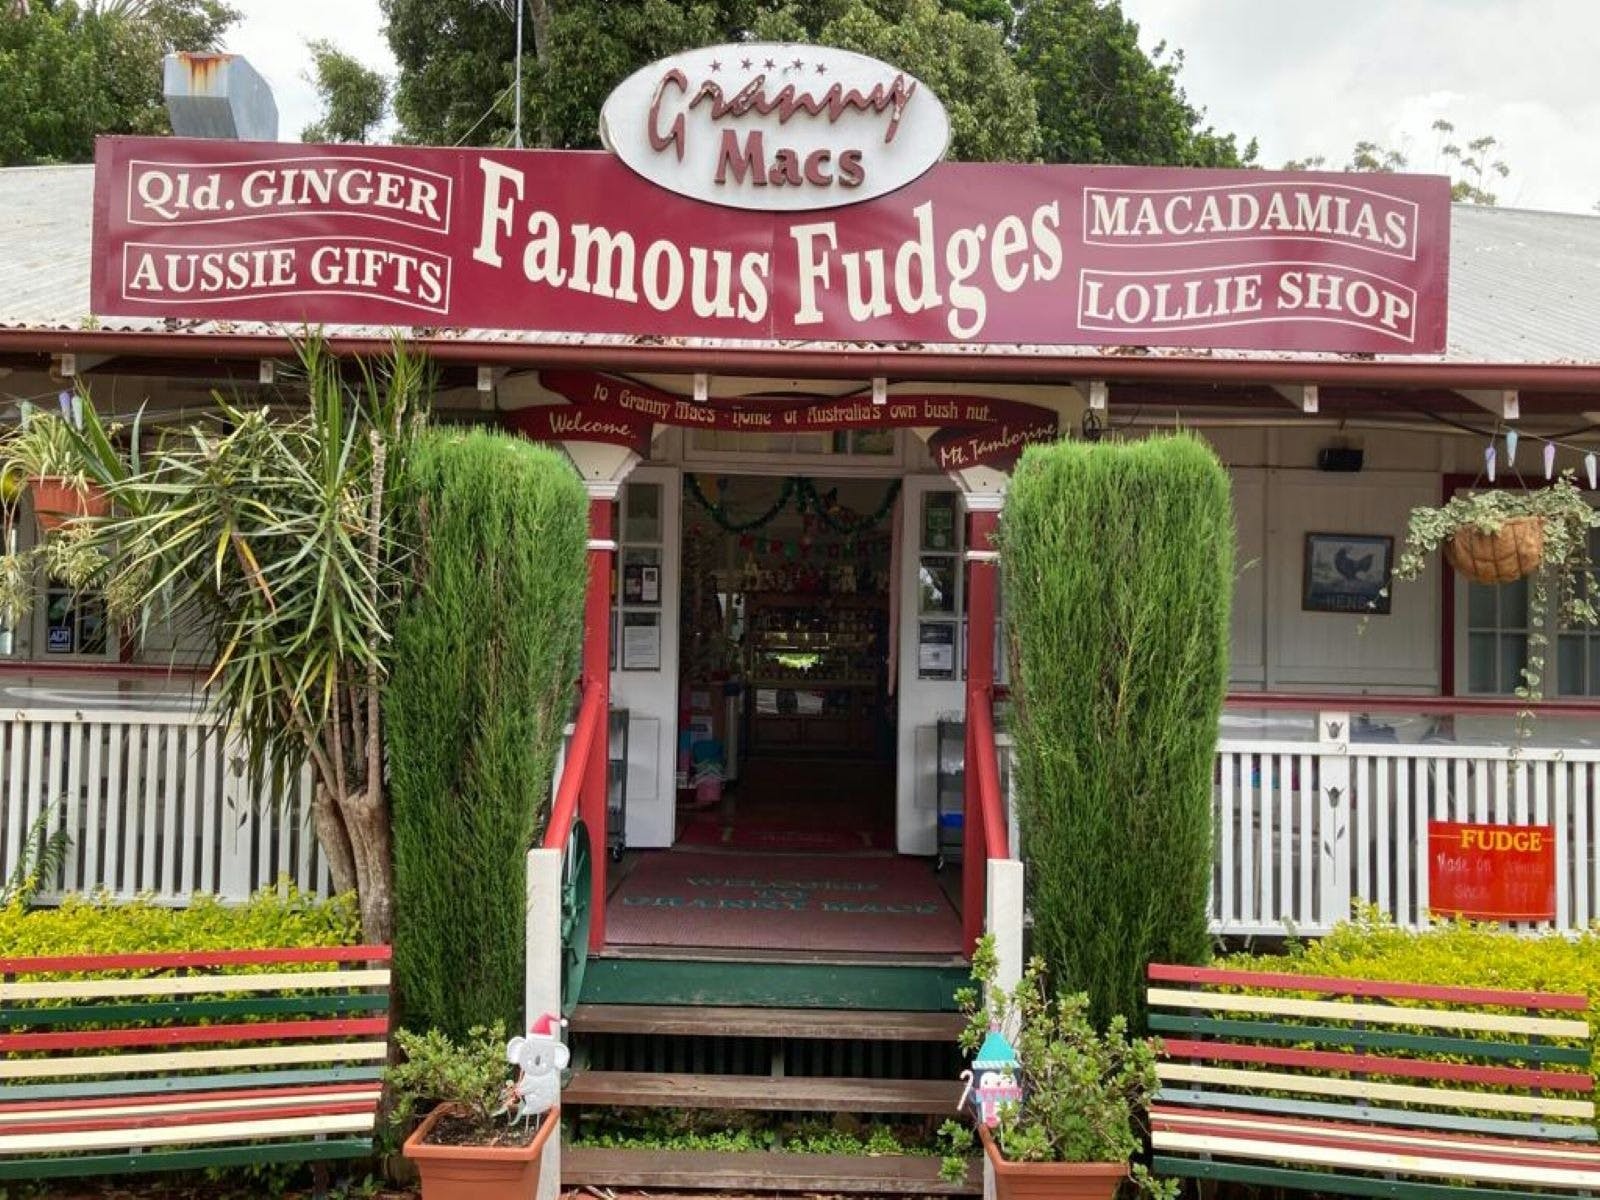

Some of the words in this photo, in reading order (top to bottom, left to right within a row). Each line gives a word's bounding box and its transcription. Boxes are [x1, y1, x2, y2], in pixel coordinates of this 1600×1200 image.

[648, 67, 917, 162] Granny
[714, 129, 866, 189] Macs
[137, 170, 236, 220] Qld.
[241, 167, 442, 222] GINGER
[1090, 192, 1408, 249] MACADAMIAS
[129, 249, 298, 293] AUSSIE
[310, 246, 443, 304] GIFTS
[472, 156, 770, 324] Famous
[789, 199, 1063, 340] Fudges
[1084, 274, 1263, 324] LOLLIE
[1276, 271, 1410, 329] SHOP
[619, 389, 671, 419] Granny
[807, 403, 881, 423] Australia's
[890, 405, 916, 419] own
[924, 400, 958, 419] bush
[941, 446, 968, 468] Mt.
[969, 423, 1057, 461] Tamborine
[49, 630, 69, 642] ADT
[1461, 829, 1543, 852] FUDGE
